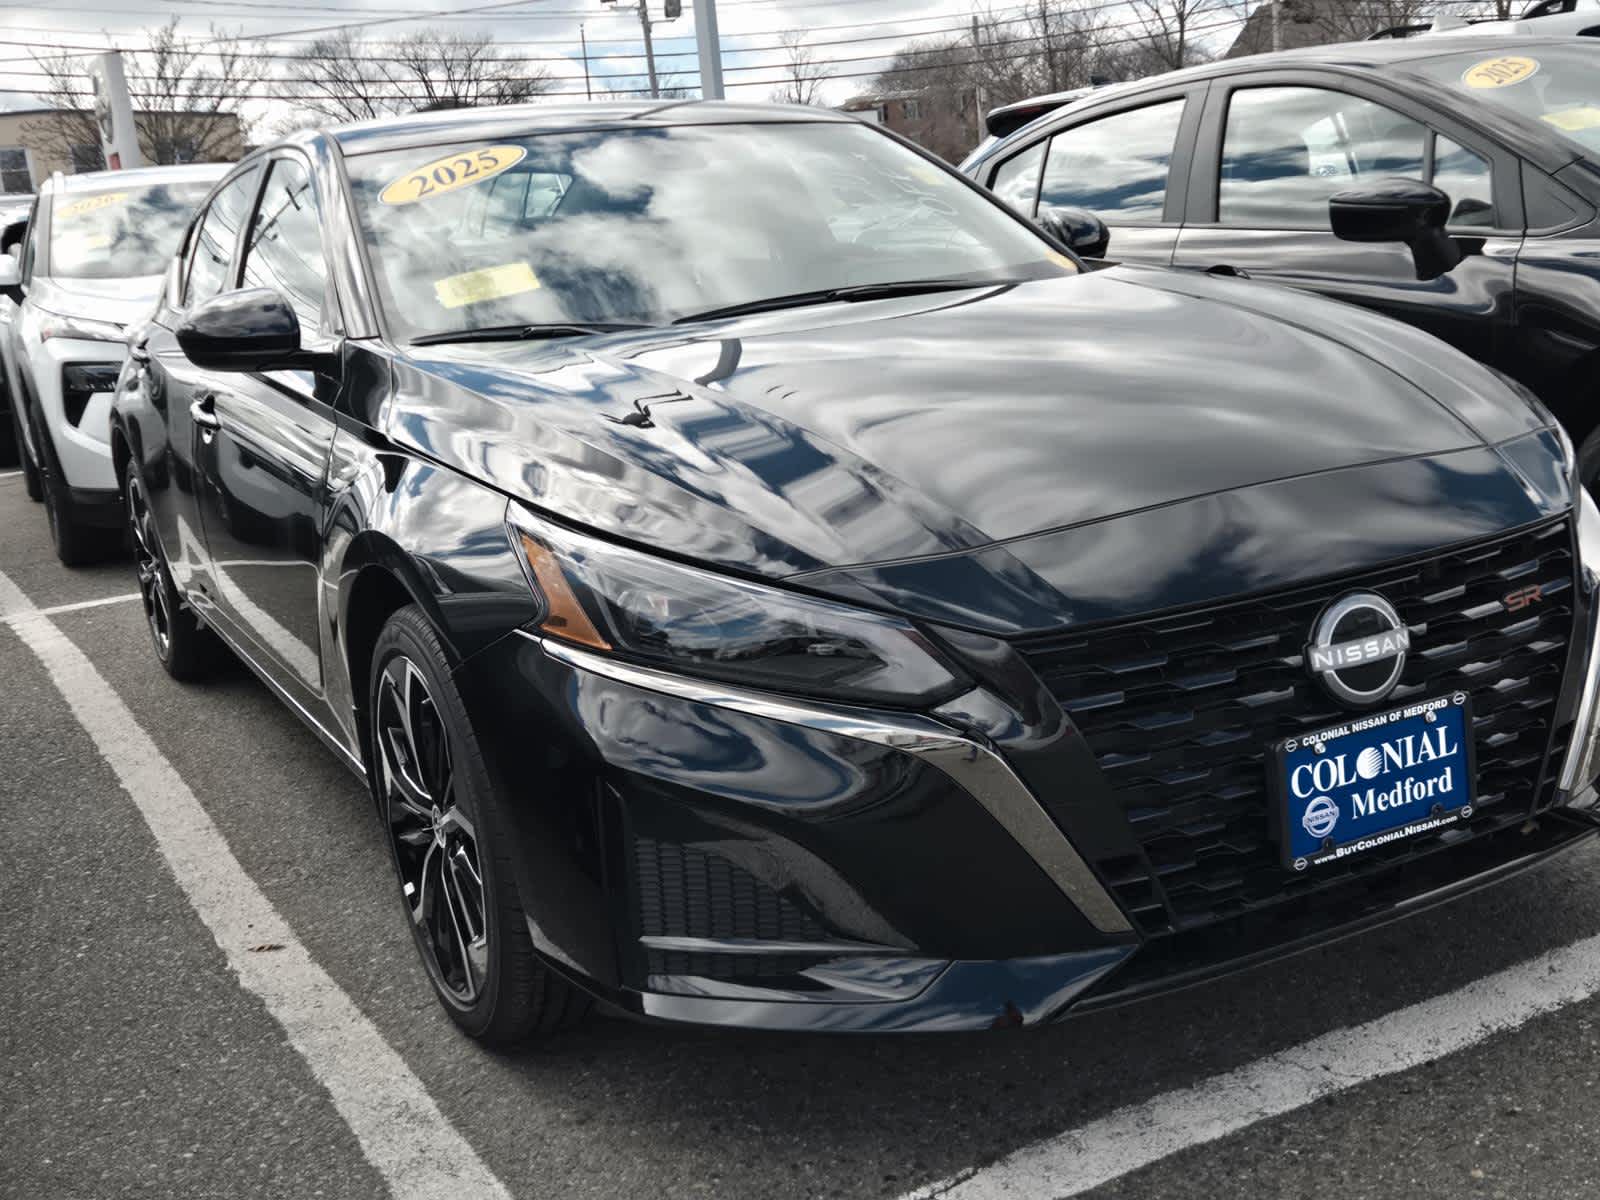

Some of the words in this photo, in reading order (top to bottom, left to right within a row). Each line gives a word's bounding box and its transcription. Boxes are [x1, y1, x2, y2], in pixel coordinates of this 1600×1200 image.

[1475, 58, 1528, 84] 2025
[408, 149, 500, 197] 2025
[1504, 584, 1543, 612] SR
[1312, 629, 1410, 669] NISSAN
[1302, 726, 1350, 747] COLONIAL
[1352, 715, 1387, 732] NISSAN
[1389, 710, 1402, 722] OF
[1403, 698, 1448, 718] MEDFORD
[1291, 725, 1458, 798] COLONIAL
[1352, 766, 1454, 820] Medford
[1306, 810, 1336, 824] NISSAN
